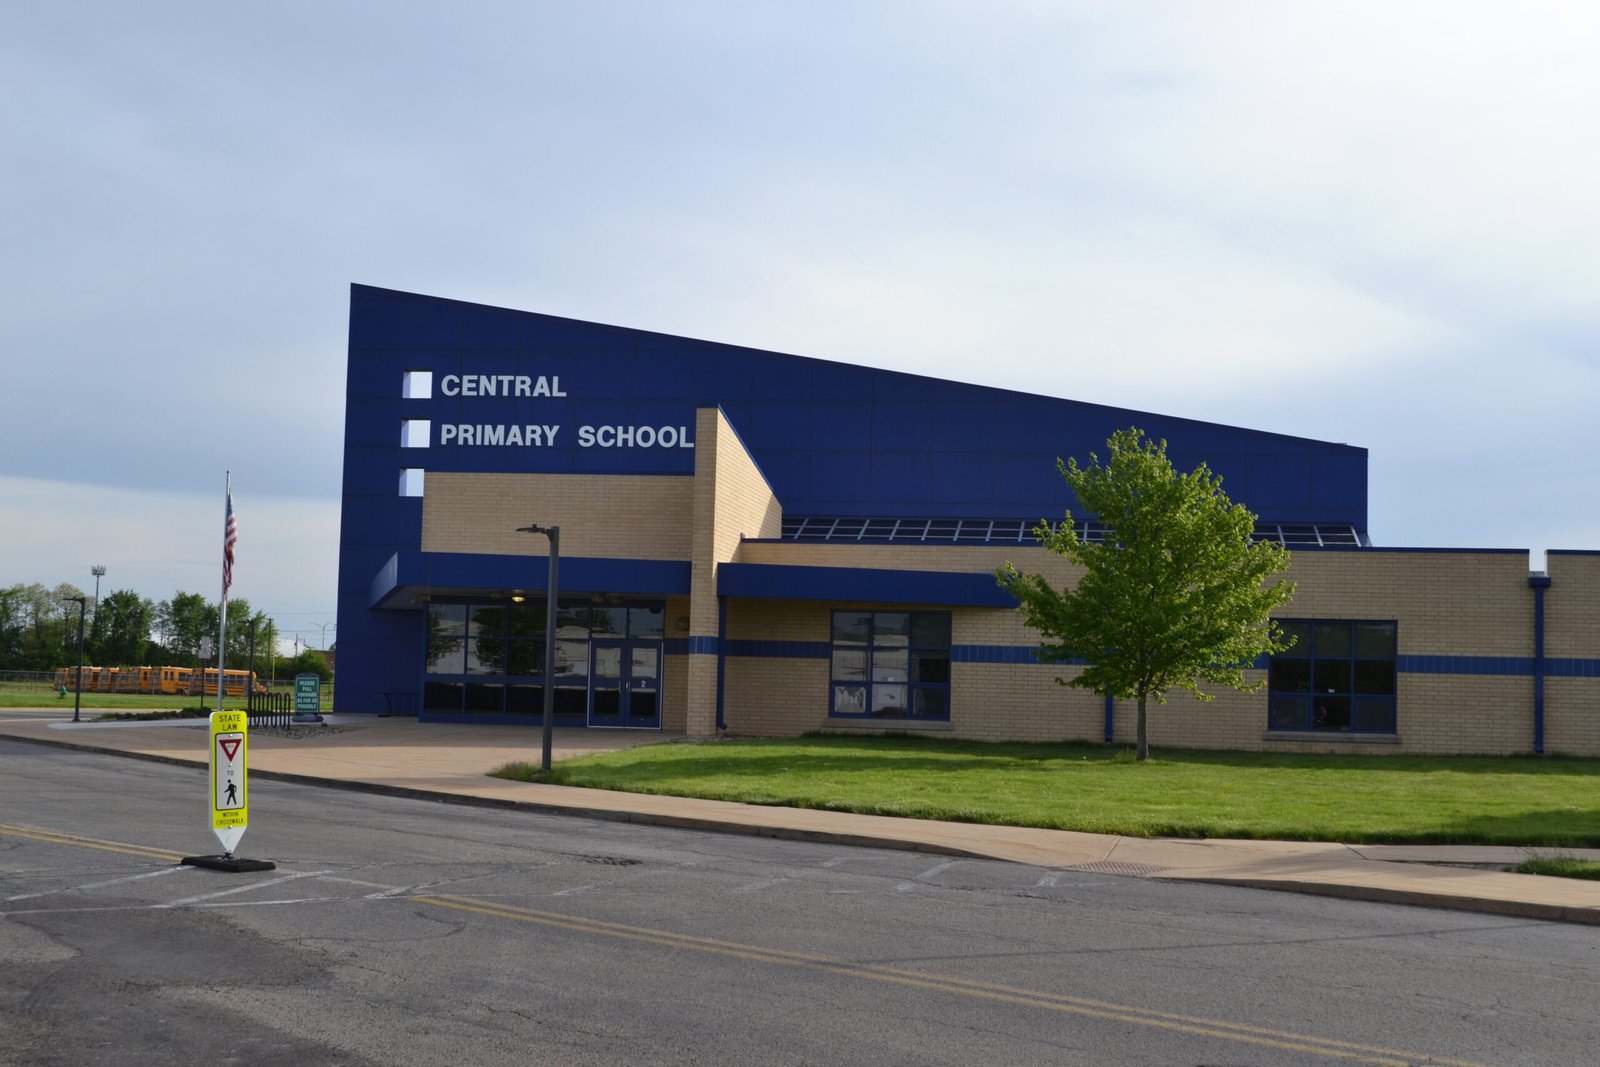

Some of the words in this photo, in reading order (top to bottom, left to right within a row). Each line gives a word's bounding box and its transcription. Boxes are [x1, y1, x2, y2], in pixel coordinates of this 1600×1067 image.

[441, 374, 567, 397] CENTRAL
[440, 424, 560, 446] PRIMARY
[578, 425, 694, 448] SCHOOL
[641, 680, 646, 688] 2
[219, 714, 241, 722] STATE
[216, 818, 244, 826] CROSSWALK
